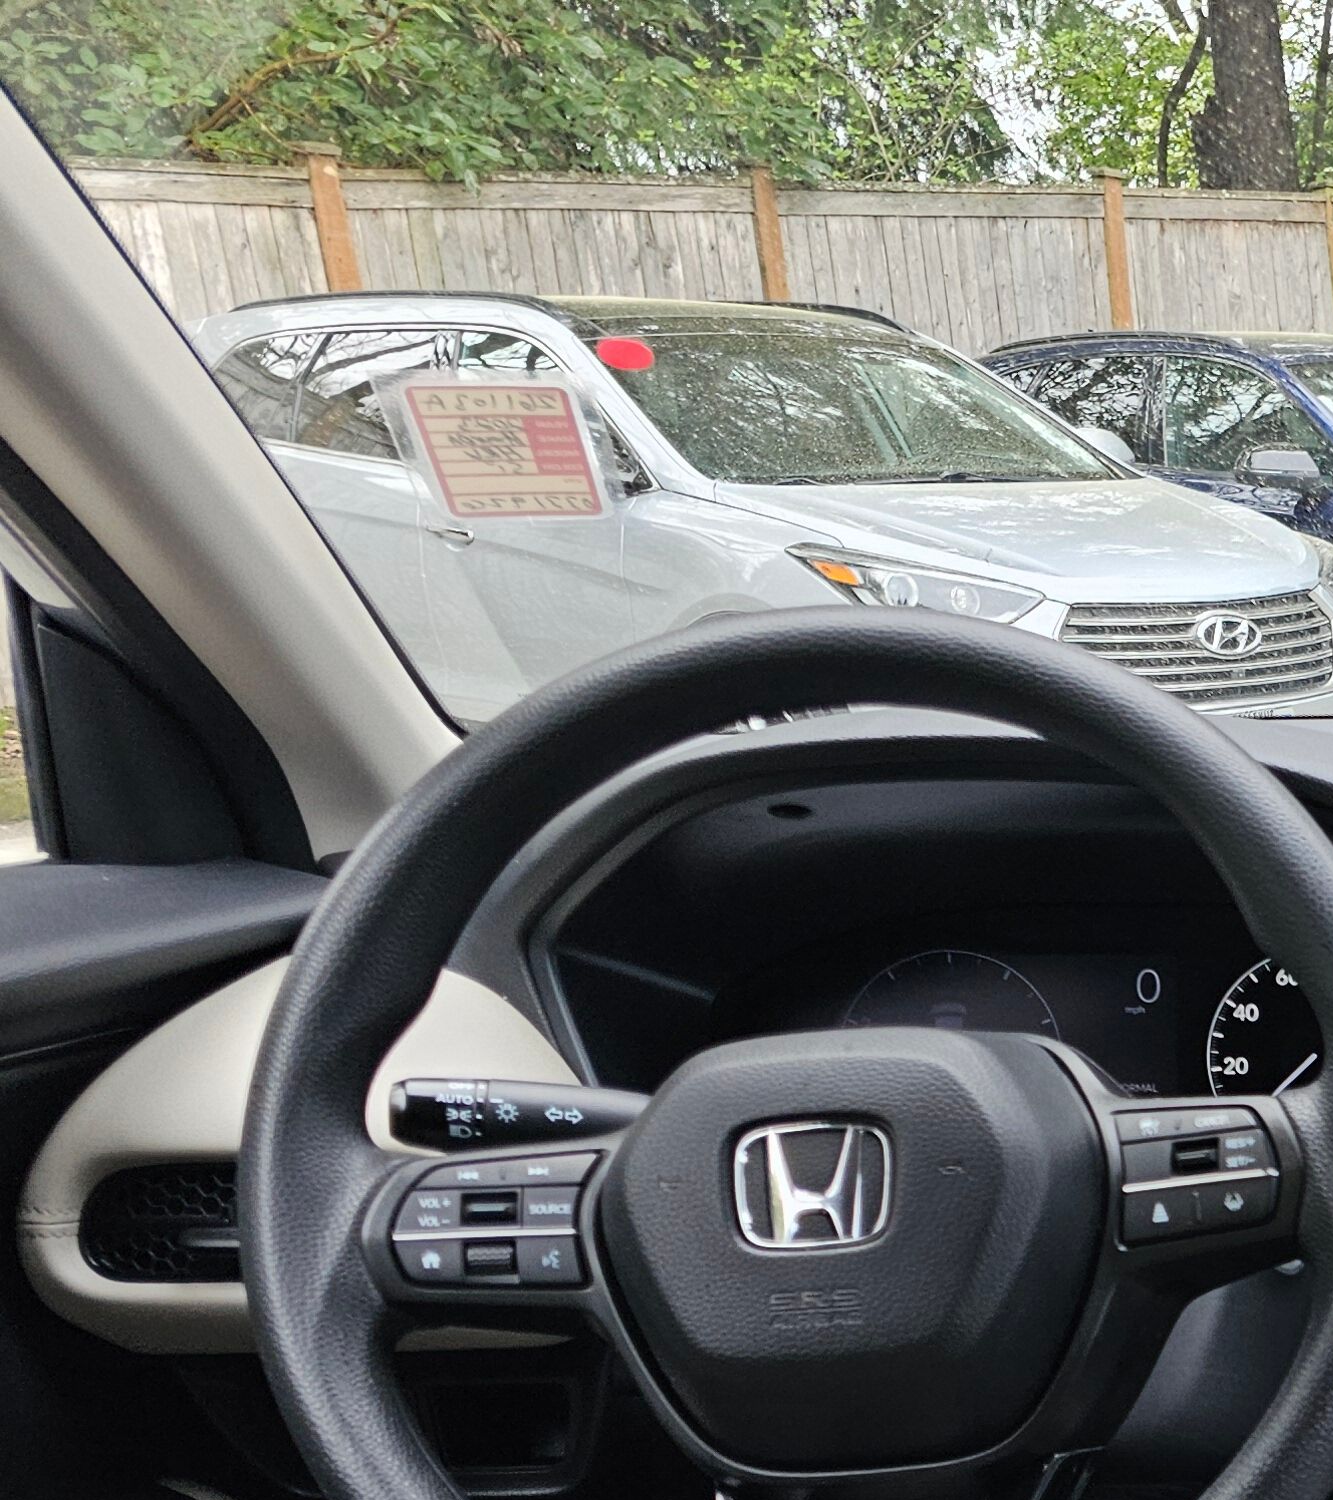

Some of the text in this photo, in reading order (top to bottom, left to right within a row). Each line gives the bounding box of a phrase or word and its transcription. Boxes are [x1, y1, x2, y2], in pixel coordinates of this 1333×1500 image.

[1136, 968, 1161, 1004] 0
[1232, 1003, 1260, 1022] 40
[1222, 1056, 1250, 1075] 20
[436, 1094, 474, 1105] AUTO
[418, 1198, 440, 1209] VOL
[528, 1203, 571, 1215] SOURCE
[417, 1215, 440, 1227] VOL
